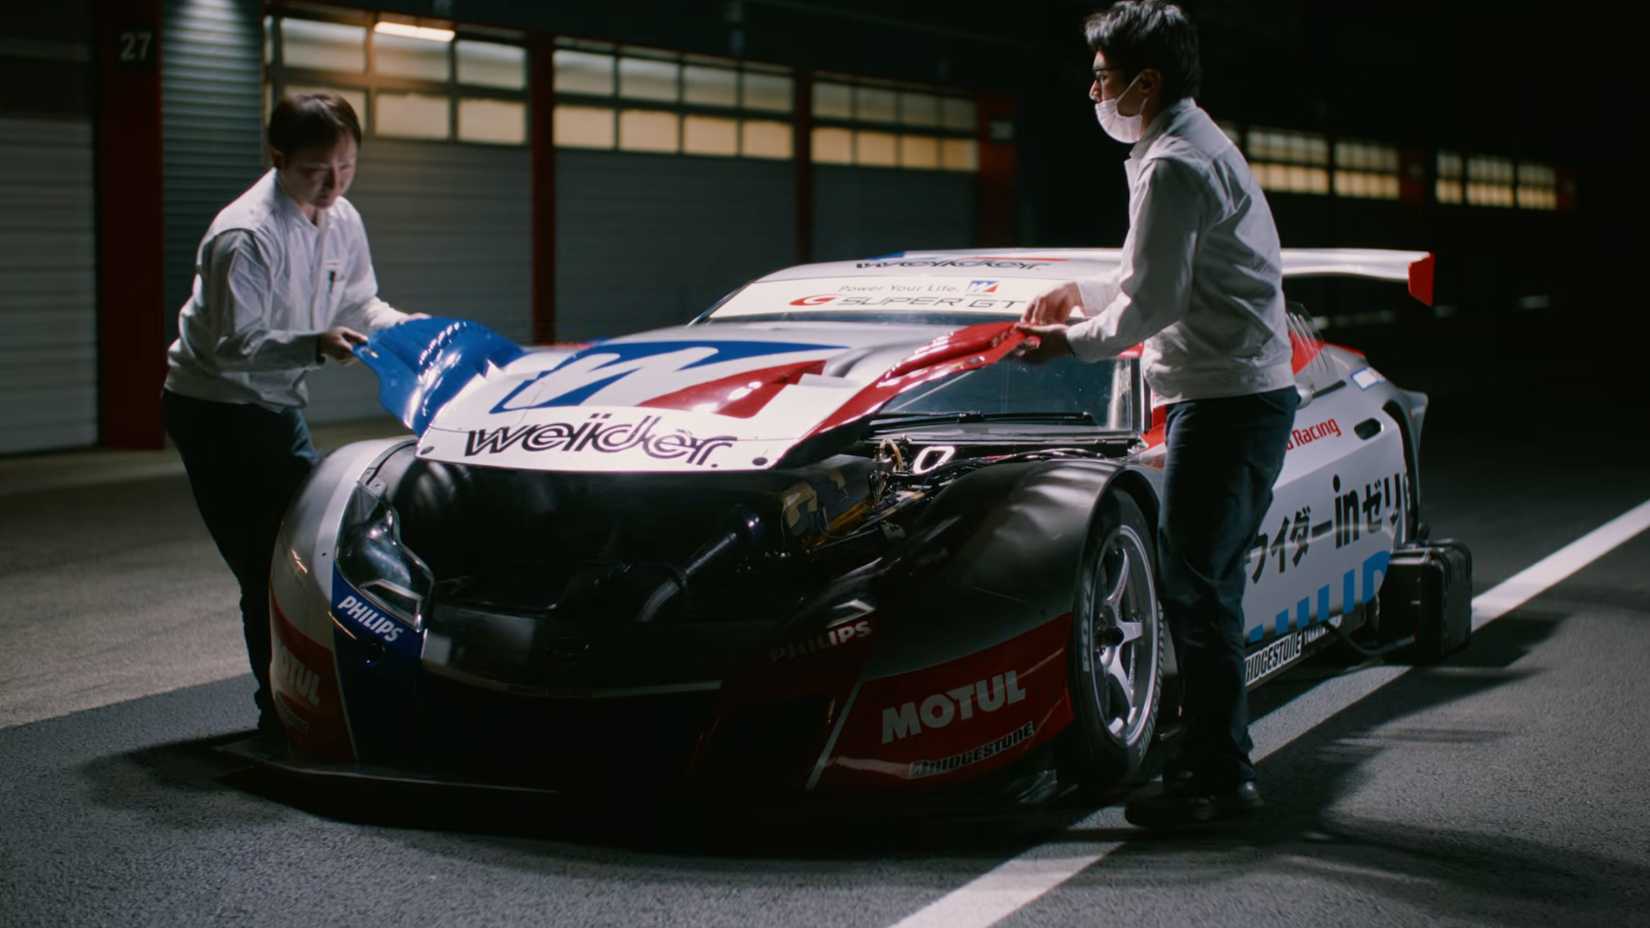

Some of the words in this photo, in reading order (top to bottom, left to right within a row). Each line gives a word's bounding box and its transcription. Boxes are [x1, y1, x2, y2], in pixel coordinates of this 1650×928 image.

[119, 31, 152, 63] 27
[836, 296, 962, 307] SUPER
[967, 298, 1027, 309] GT
[839, 284, 881, 293] Power
[889, 284, 922, 293] Your
[1292, 418, 1342, 447] Racing
[336, 595, 404, 642] PHILIPS
[881, 669, 1026, 744] MOTUL
